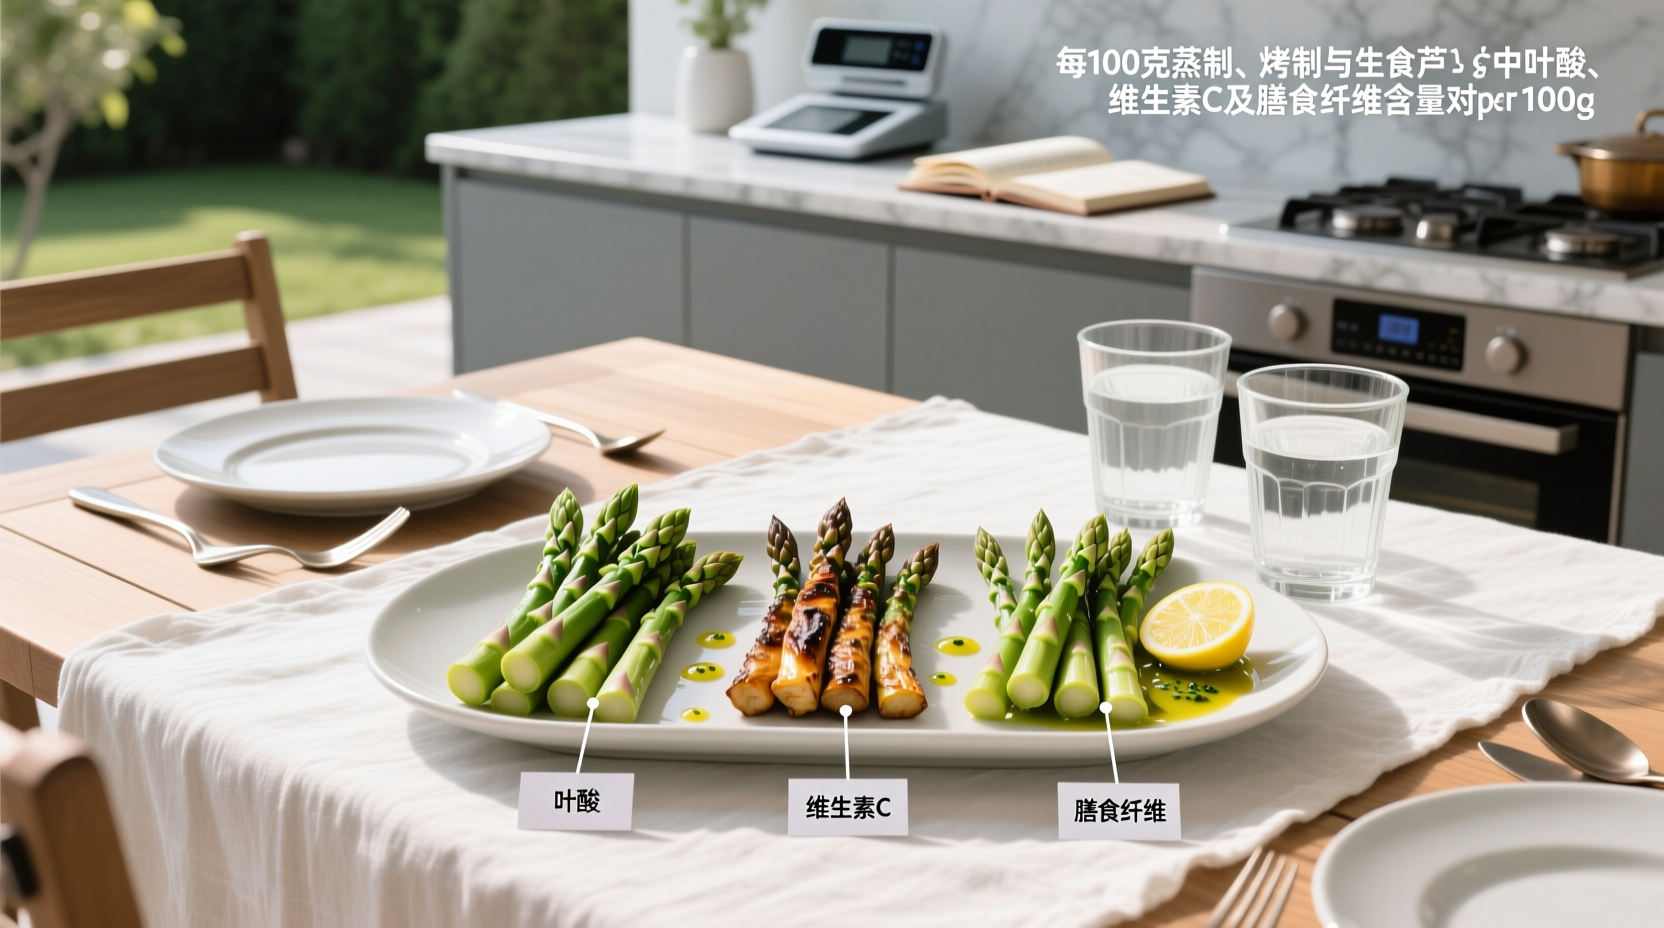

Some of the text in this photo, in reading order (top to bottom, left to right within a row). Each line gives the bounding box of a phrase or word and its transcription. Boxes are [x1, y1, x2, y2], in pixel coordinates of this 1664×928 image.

[554, 787, 601, 815] 叶酸
[805, 794, 892, 820] 维生素C
[1074, 797, 1167, 823] 膳食纤维
